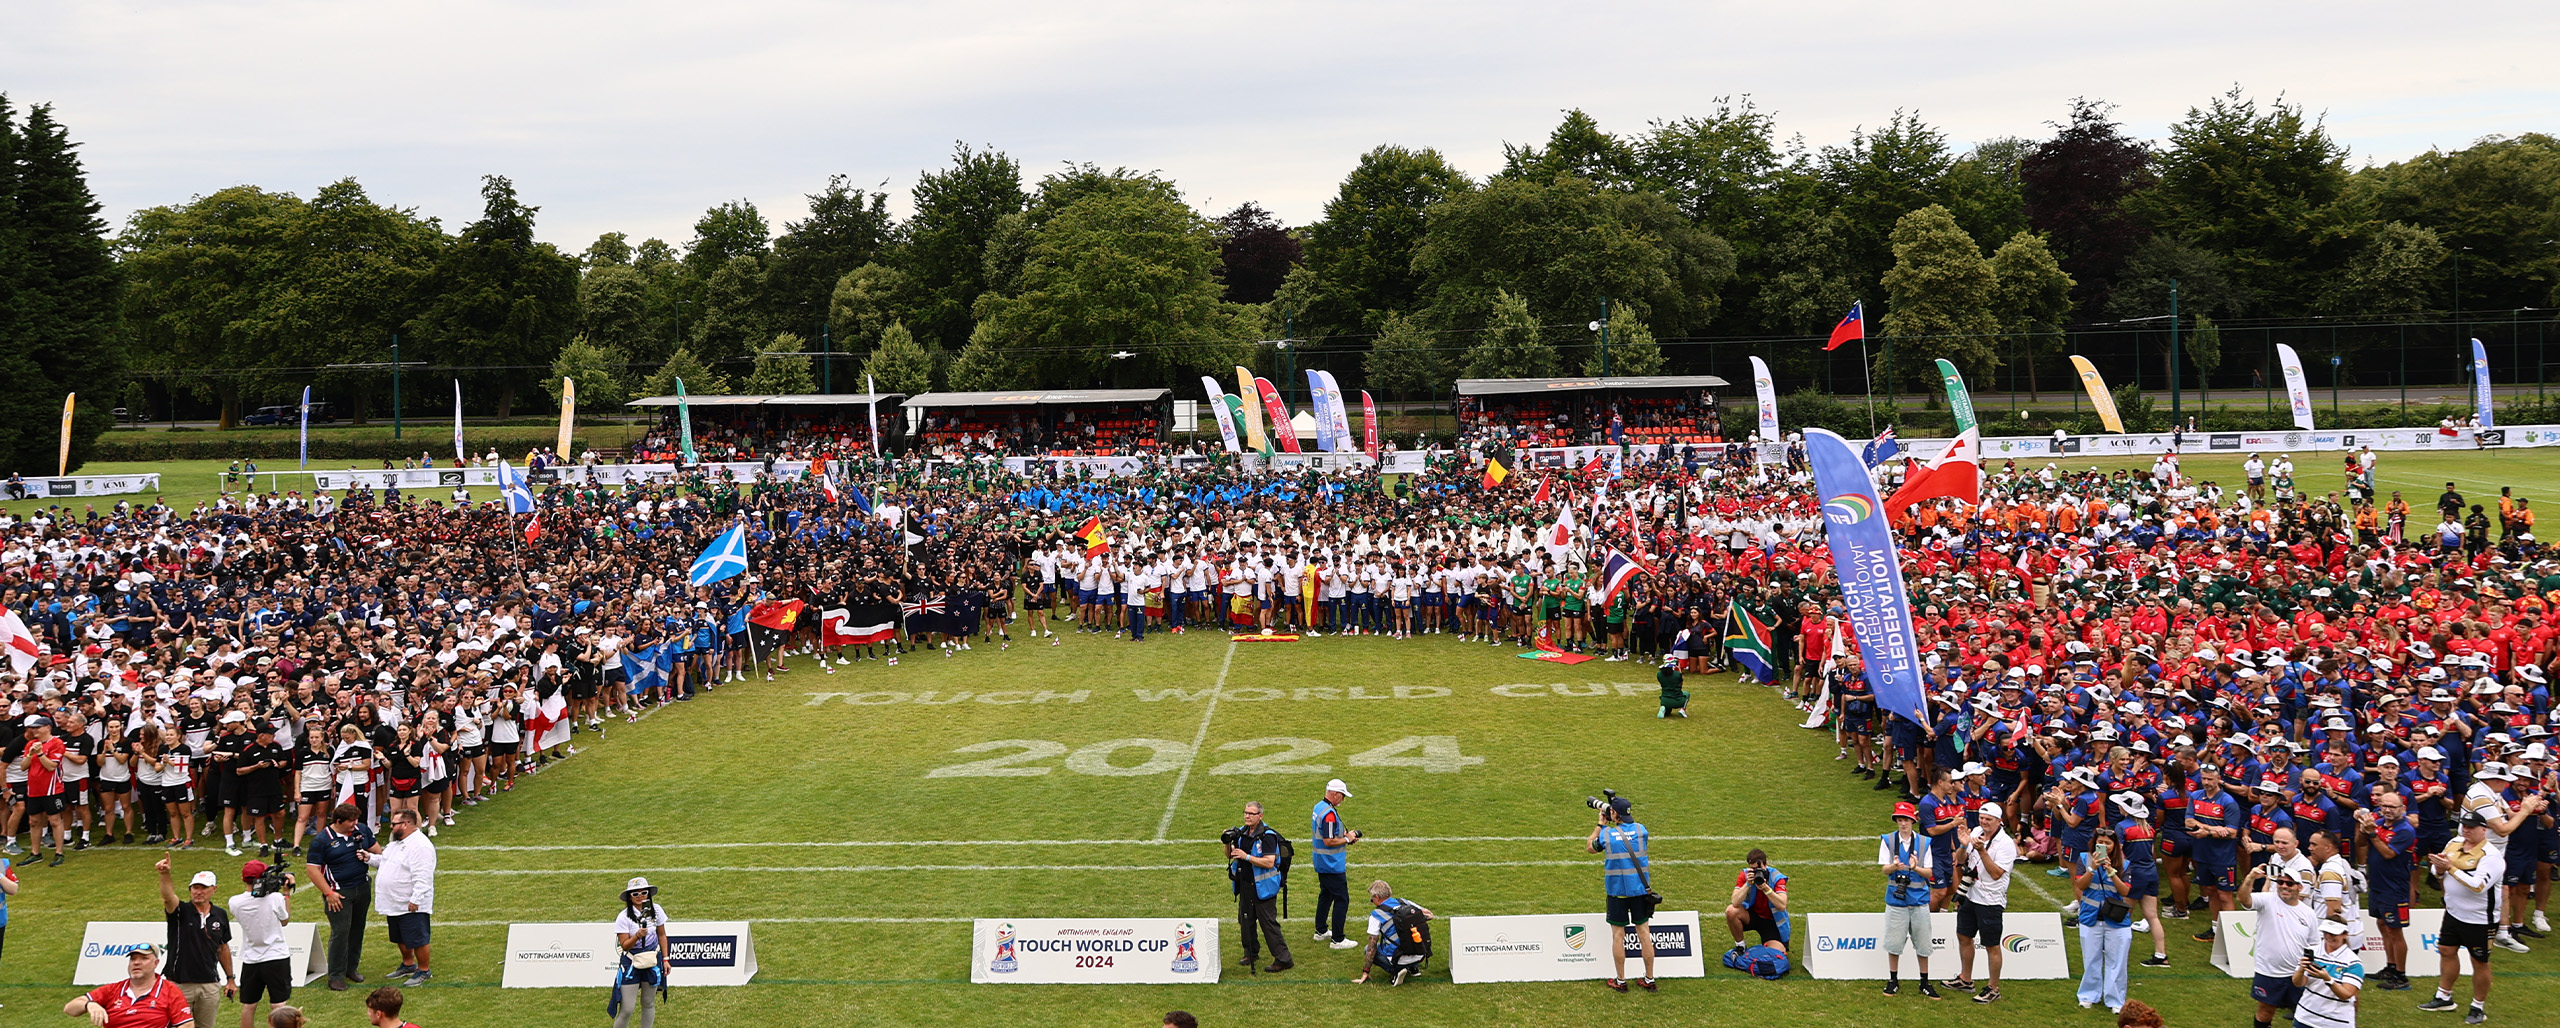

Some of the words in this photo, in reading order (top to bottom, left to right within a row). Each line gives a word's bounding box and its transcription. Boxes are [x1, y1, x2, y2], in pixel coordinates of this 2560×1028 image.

[1897, 442, 1911, 452] 00°
[2109, 439, 2137, 447] ACME
[103, 481, 128, 489] ACME
[1617, 597, 1623, 608] 2
[801, 687, 1092, 707] TOUCH
[1133, 684, 1452, 703] WORLD
[1490, 681, 1661, 698] CUP
[923, 735, 1486, 779] 2024
[1103, 928, 1134, 936] ENGLAND
[1623, 932, 1685, 943] NOTNGHAM
[670, 942, 731, 953] NOTTINGHAM
[1018, 940, 1071, 952] TOUCH
[1075, 940, 1134, 952] WORLD
[1138, 940, 1169, 952] CUP
[1465, 944, 1513, 952] NOTTINGHAM
[1656, 942, 1685, 950] CENTRE
[1836, 938, 1876, 949] MAPEI
[2019, 944, 2031, 952] FIT
[102, 944, 130, 956] MAP
[518, 952, 564, 960] NOTTINGHAM
[670, 952, 700, 960] HOCKEY
[1075, 956, 1114, 968] 2024
